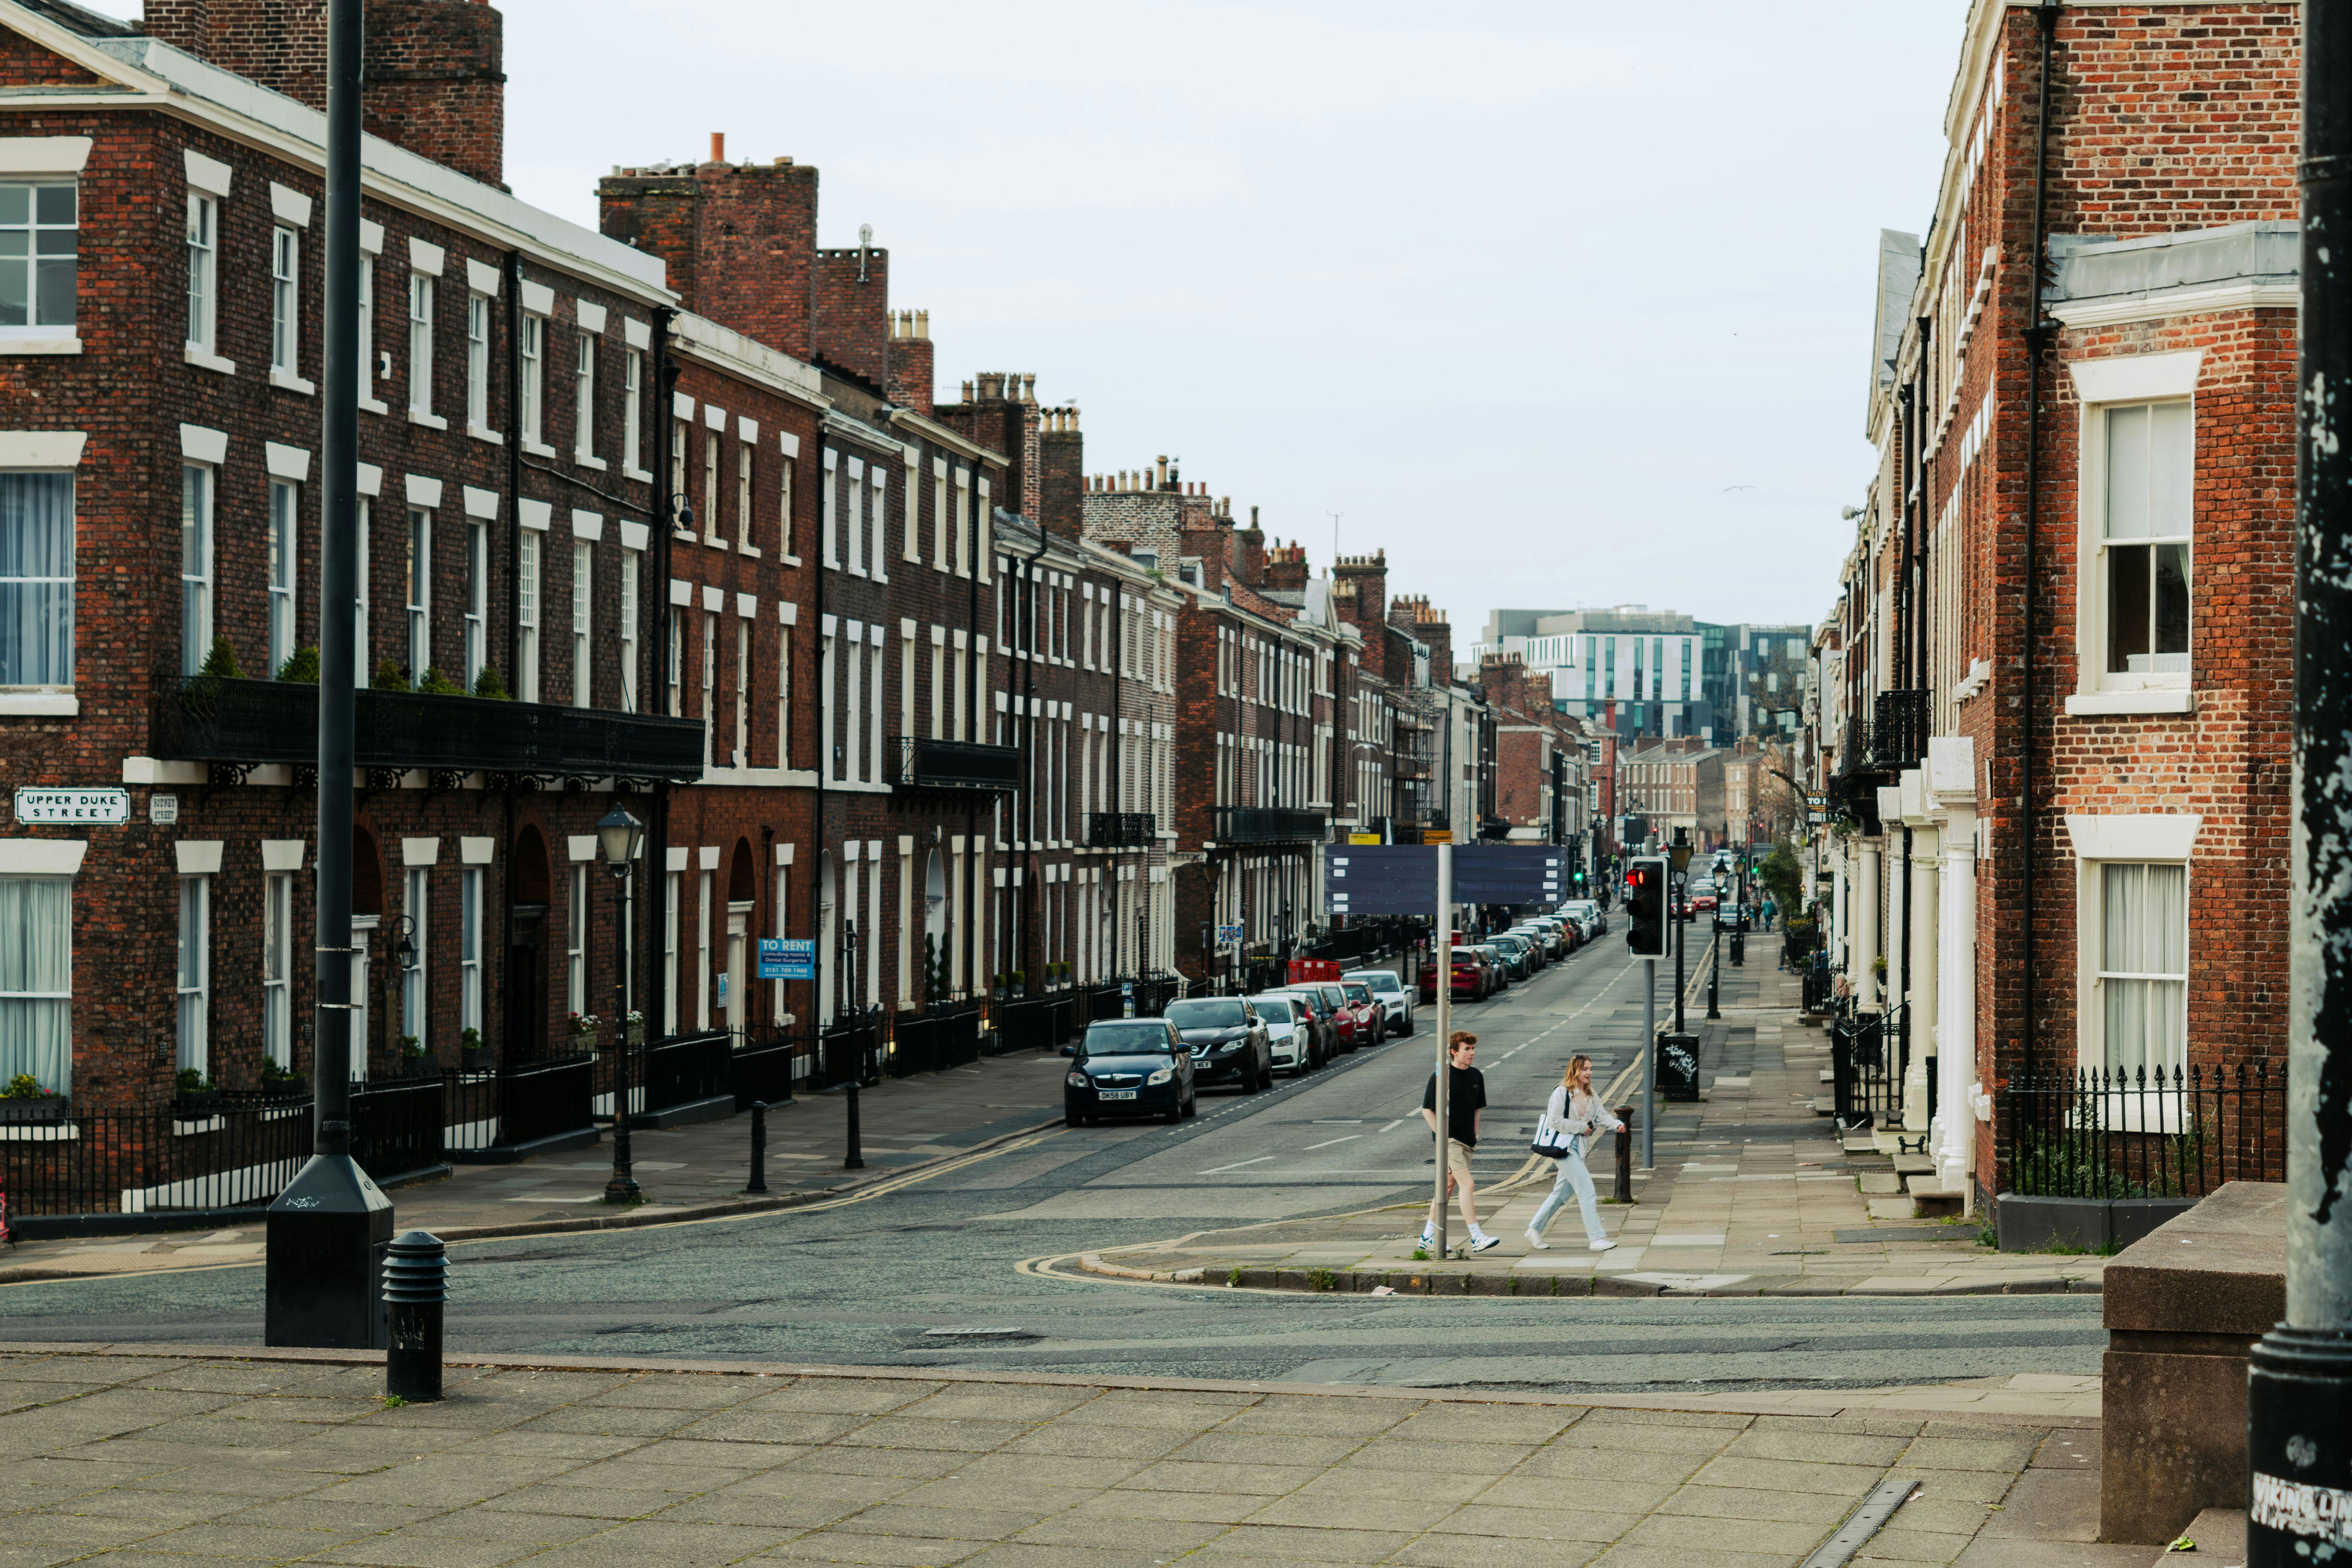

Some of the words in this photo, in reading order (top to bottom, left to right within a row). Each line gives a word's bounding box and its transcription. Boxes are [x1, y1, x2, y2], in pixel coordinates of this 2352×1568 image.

[27, 796, 71, 804] UPPER
[80, 796, 117, 804] DUKE
[154, 798, 175, 807] RODNEY
[33, 808, 111, 817] STREET
[154, 810, 174, 819] STREET
[762, 940, 778, 950] TO
[782, 940, 811, 951] RENT
